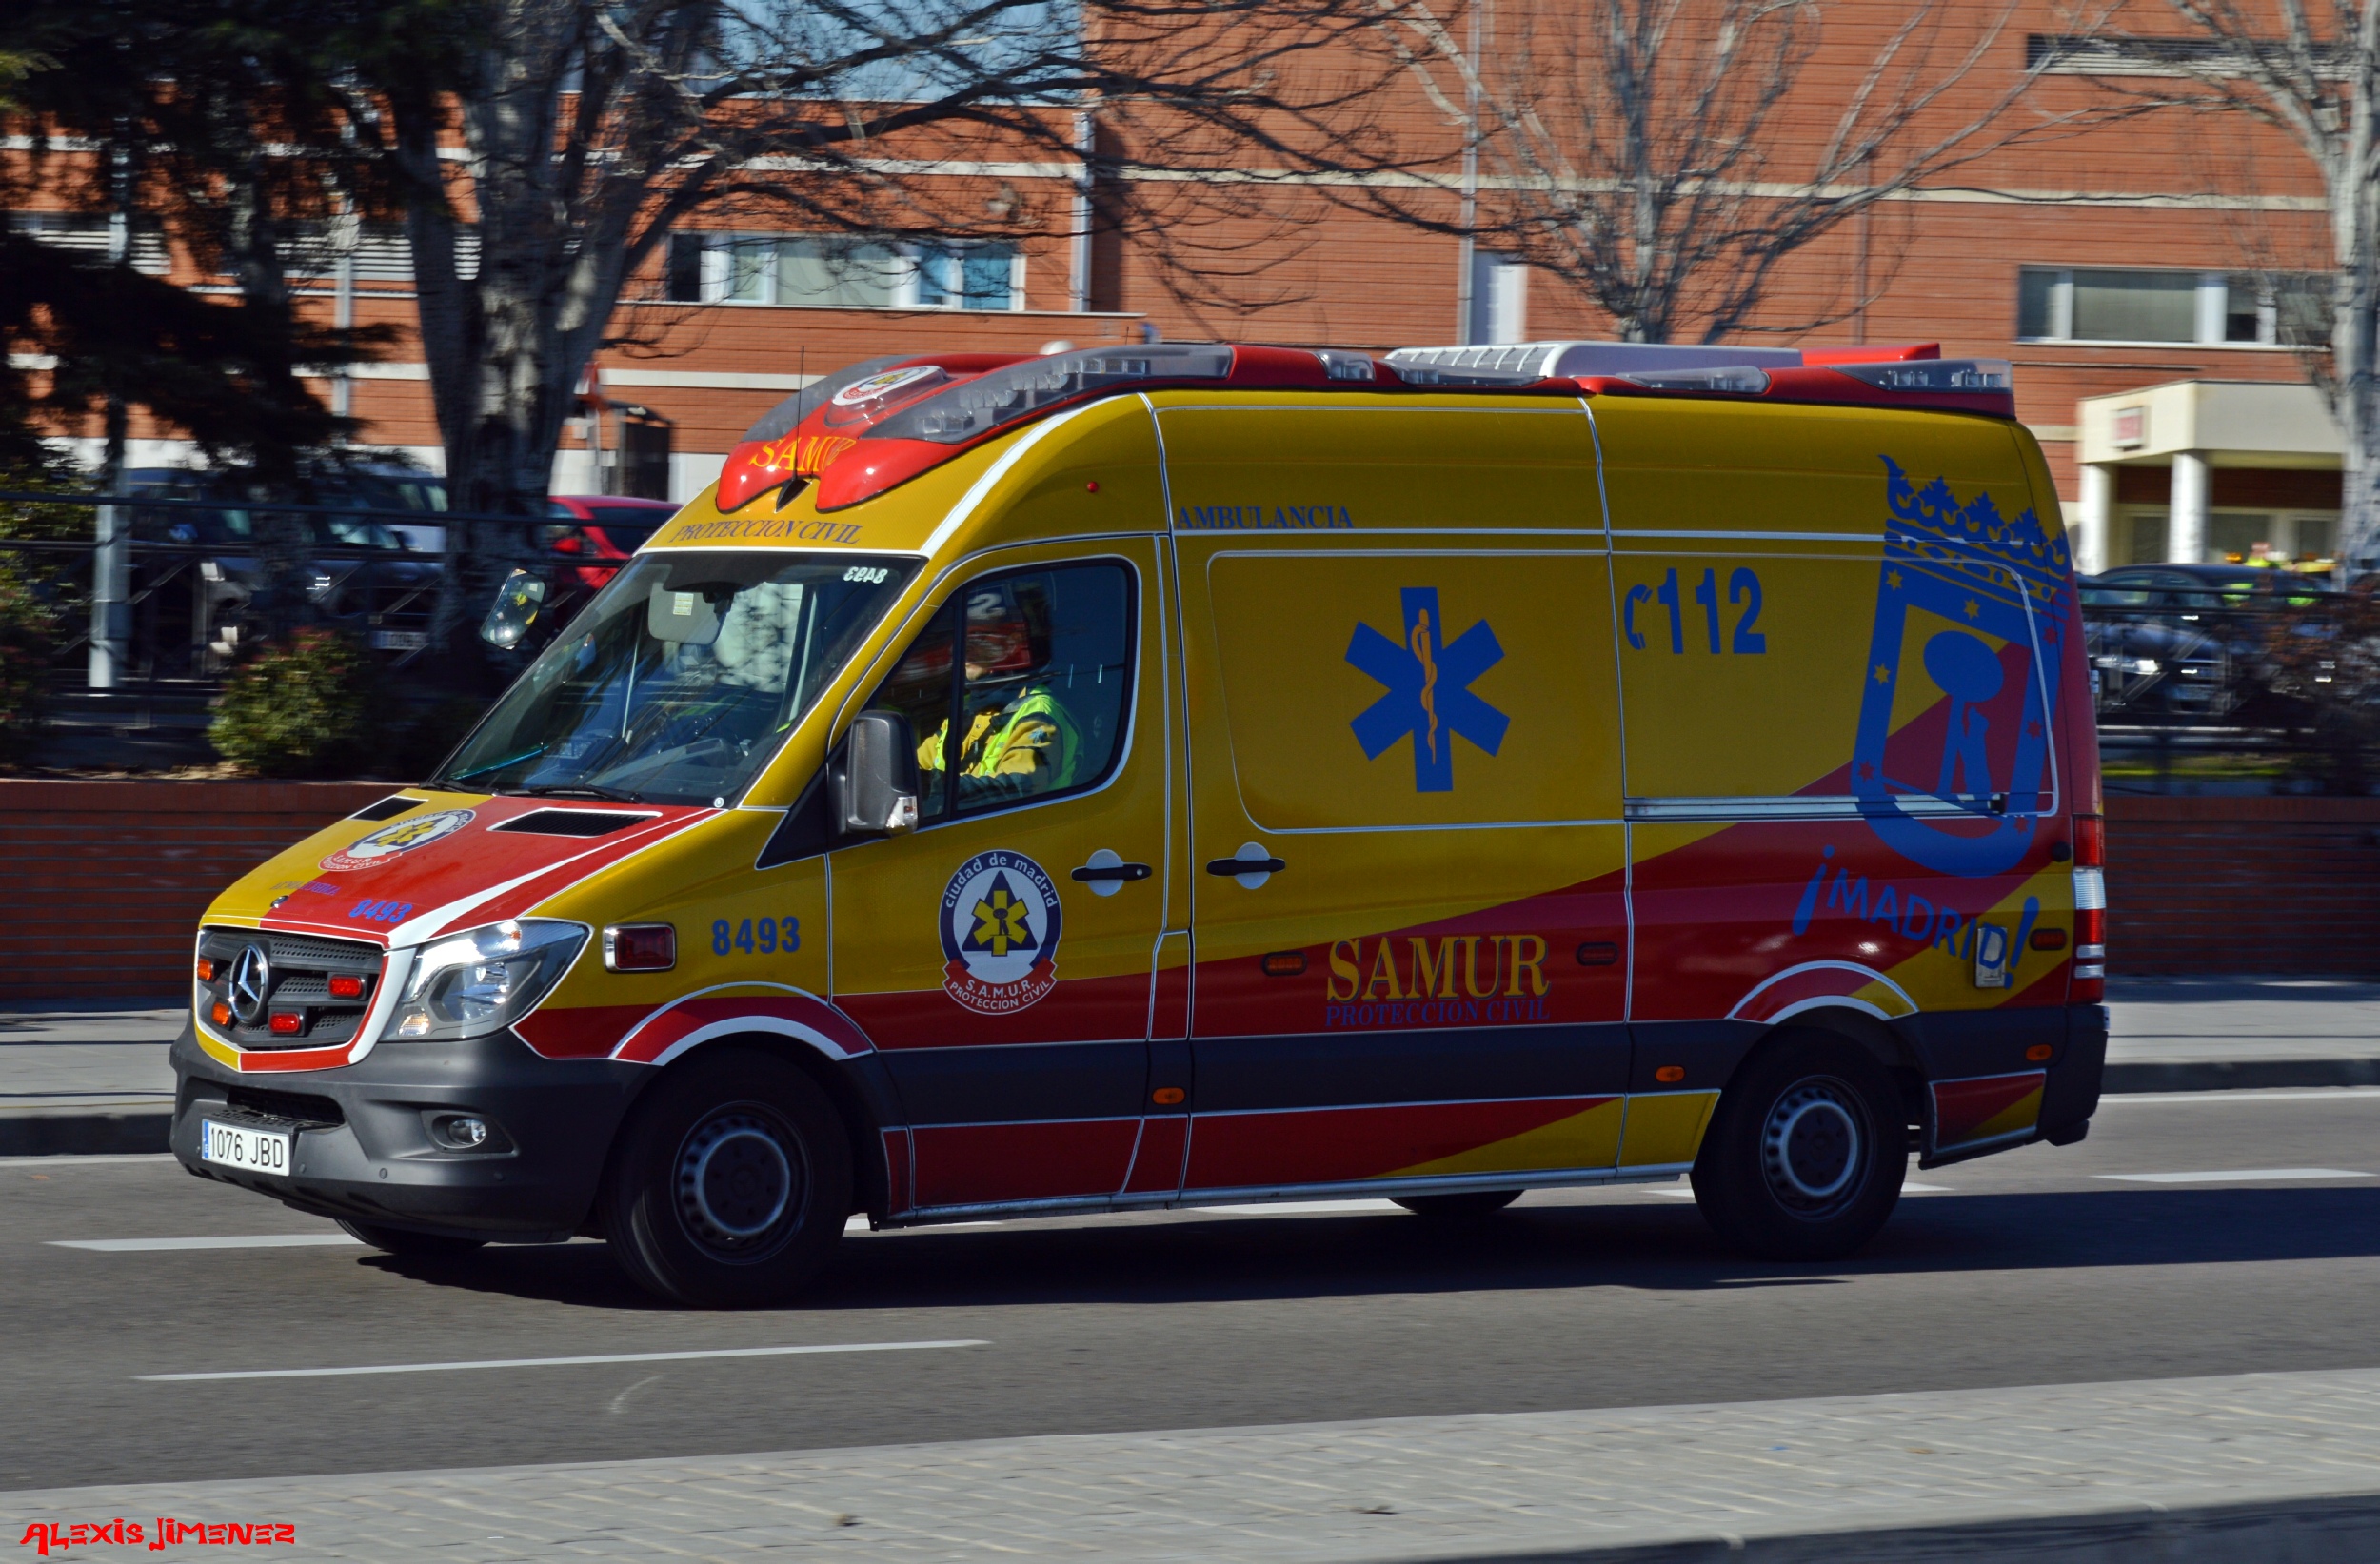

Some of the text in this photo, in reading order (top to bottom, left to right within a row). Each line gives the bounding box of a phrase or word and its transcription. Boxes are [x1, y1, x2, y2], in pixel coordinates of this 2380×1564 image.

[1177, 505, 1355, 529] AMBULANCIA
[668, 520, 863, 544] PROTECCION CIVIL
[1657, 567, 1767, 654] 112
[945, 853, 1058, 908] ciudad de madrid
[348, 899, 412, 922] 8493
[712, 916, 801, 956] 8493
[1326, 934, 1552, 1003] SAMUR
[950, 981, 1050, 1010] PROTECCION CIVIL
[966, 980, 1034, 998] S.A.M.U.R.
[1325, 1000, 1551, 1027] PROTECCION CIVIL
[211, 1128, 243, 1161] 1076
[250, 1136, 284, 1168] JBD
